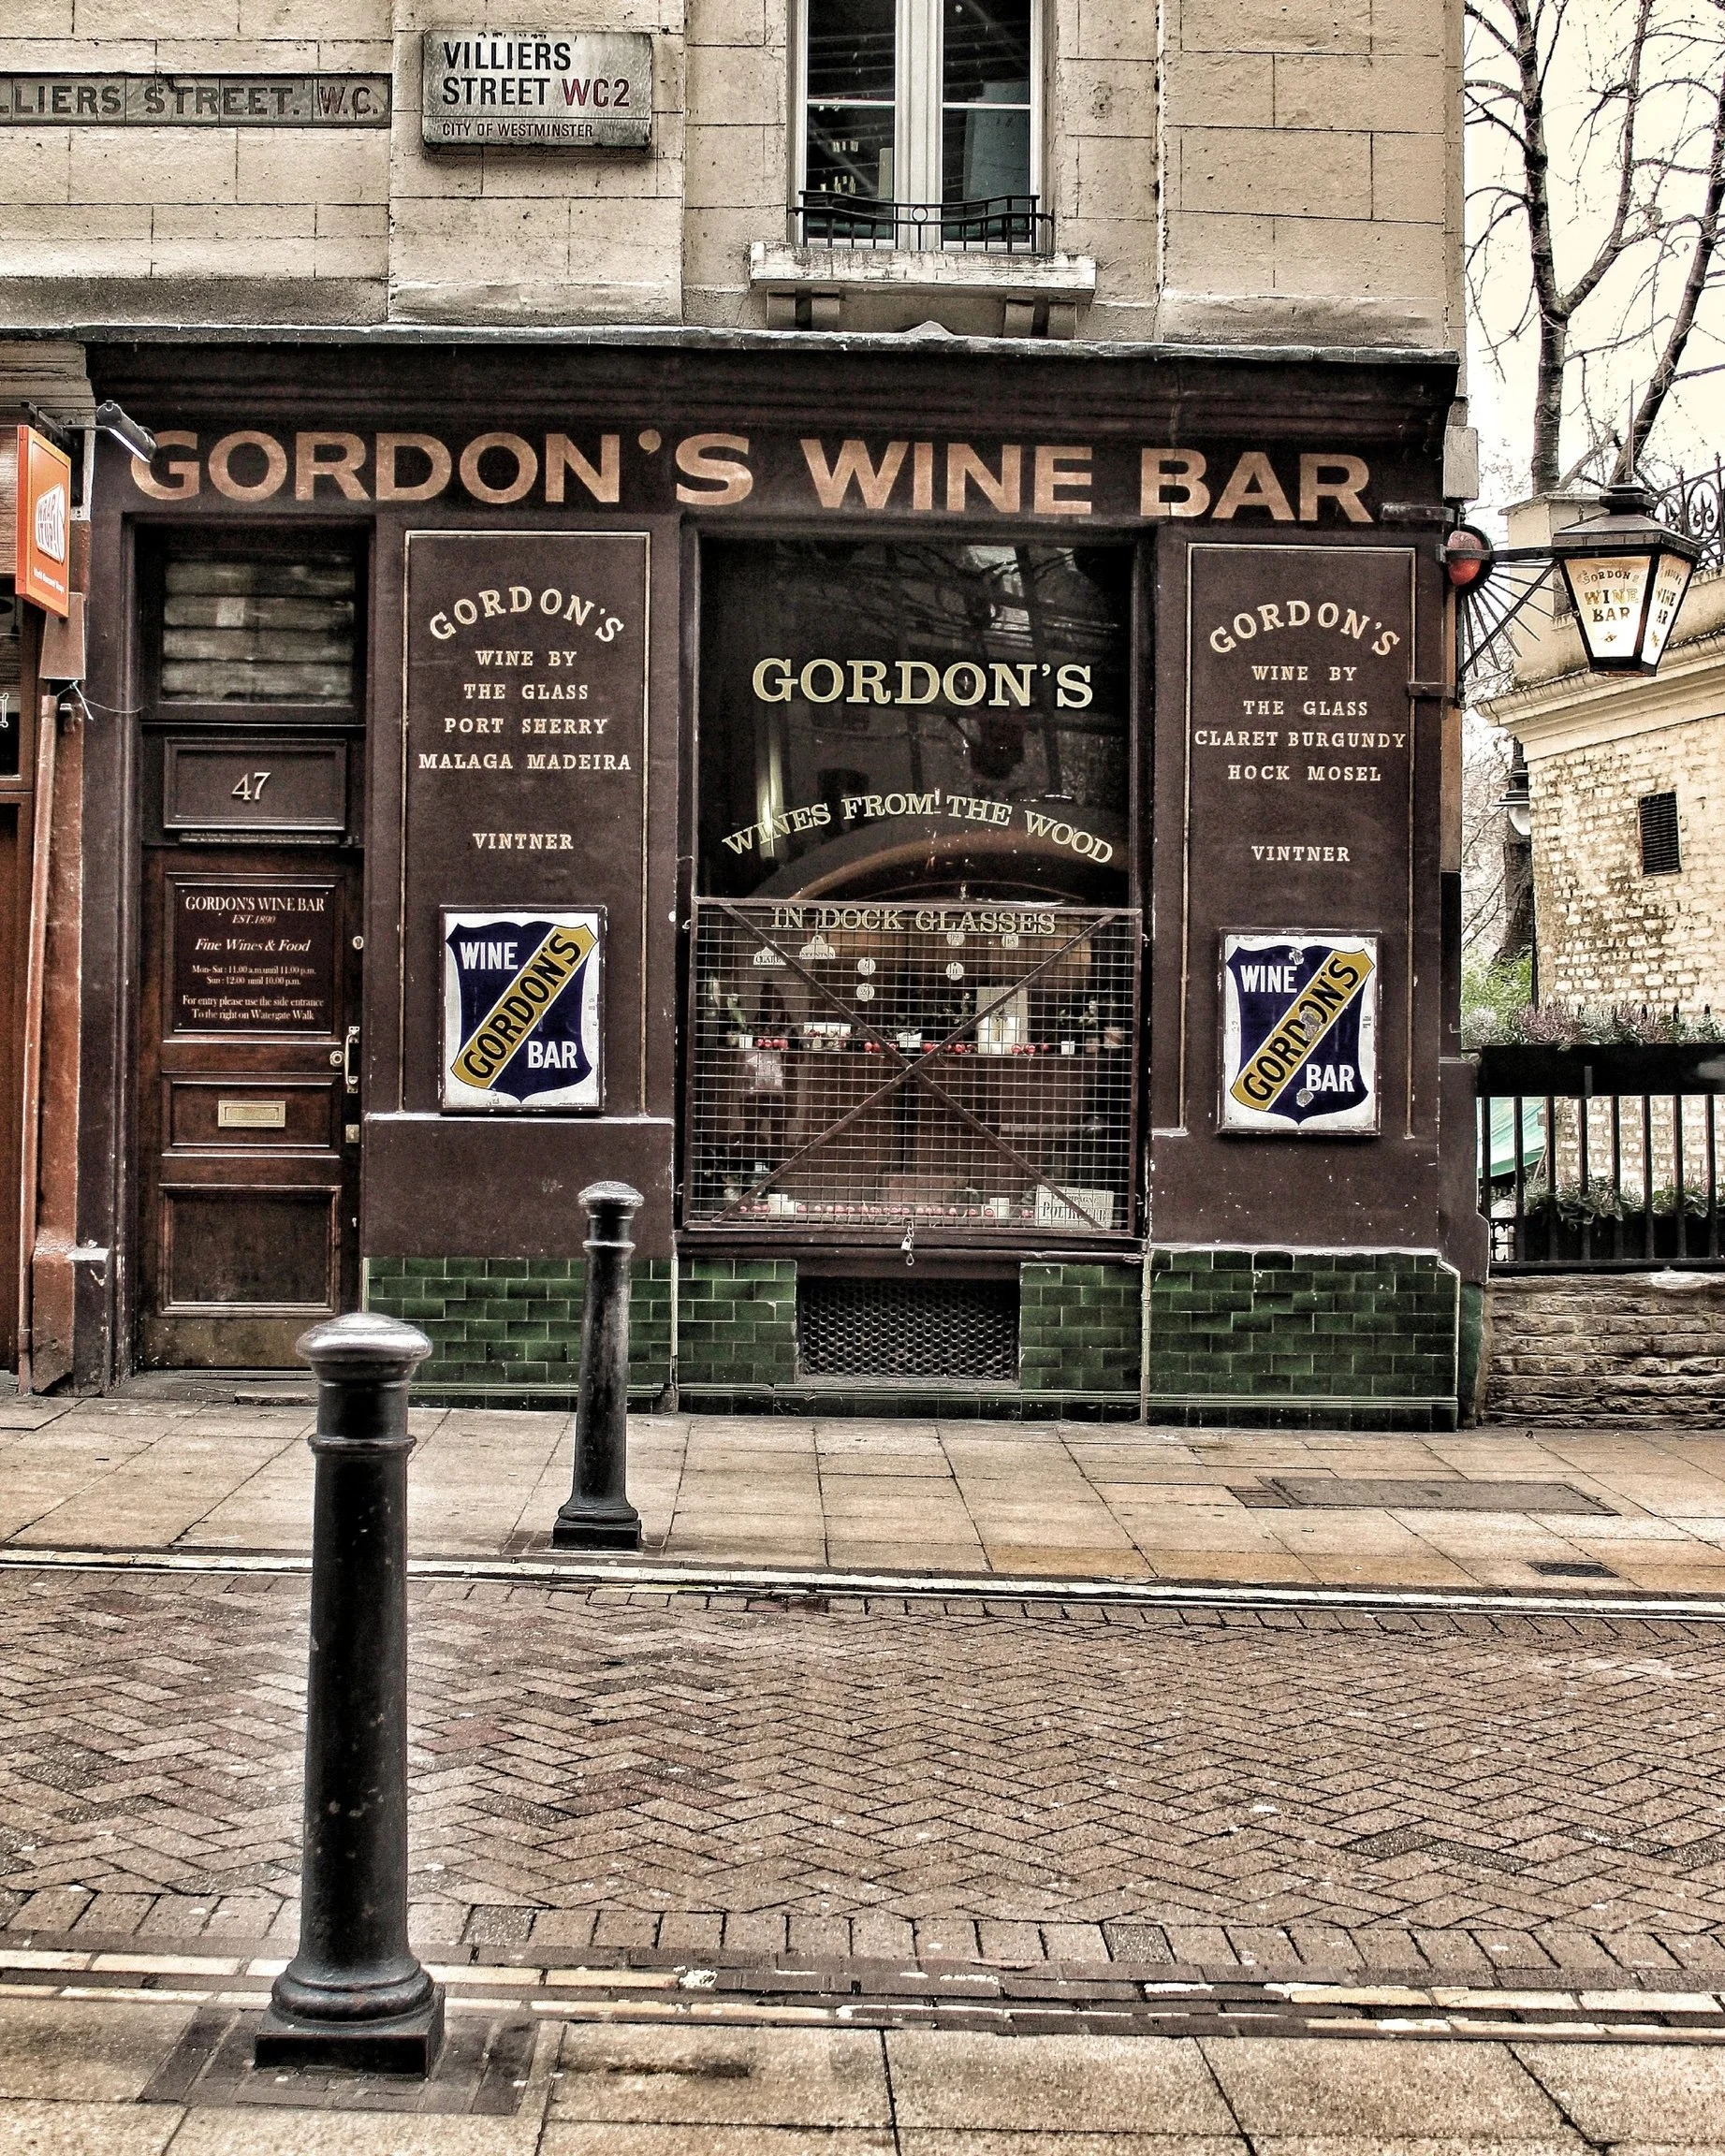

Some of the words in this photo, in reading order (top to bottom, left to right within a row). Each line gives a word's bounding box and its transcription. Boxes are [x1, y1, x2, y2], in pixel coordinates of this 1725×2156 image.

[443, 41, 572, 71] VILLIERS
[442, 78, 548, 106] STREET
[563, 79, 631, 109] WC2
[442, 123, 471, 138] CITY
[475, 123, 493, 138] OF
[497, 123, 594, 138] WESTMINSTER
[130, 429, 754, 507] GORDON'S
[800, 438, 1092, 516] WINE
[1139, 446, 1374, 524] BAR
[430, 586, 624, 643] GORDON'S
[1592, 606, 1630, 623] BAR
[1209, 599, 1401, 657] GORDON'S
[475, 650, 534, 666] WINE
[548, 650, 577, 667] BY
[752, 657, 1094, 708] GORDON'S
[1251, 665, 1308, 681] WINE
[1329, 666, 1357, 681] BY
[463, 683, 506, 700] THE
[521, 684, 589, 700] GLASS
[1243, 700, 1285, 716] THE
[1303, 701, 1368, 717] GLASS
[444, 717, 504, 734] PORT
[521, 718, 608, 735] SHERRY
[1194, 730, 1279, 747] CLARET
[1288, 731, 1407, 749] BURGUNDY
[418, 753, 514, 769] MALAGA
[527, 754, 632, 771] MADEIRA
[1228, 765, 1291, 780] HOCK
[1308, 765, 1382, 781] MOSEL
[231, 772, 271, 801] 47
[722, 802, 832, 856] WINES
[946, 794, 1013, 827] THE
[1024, 809, 1114, 866] WOOD
[472, 833, 574, 850] VINTNER
[1250, 845, 1352, 863] VINTNER
[185, 896, 256, 911] GORDON'S
[257, 896, 296, 912] WINE
[298, 897, 325, 912] BAR
[770, 907, 804, 929] IN
[819, 908, 905, 931] DOCK
[915, 910, 1057, 936] GLASSES
[195, 938, 223, 951] Fine
[227, 939, 263, 951] Wines
[265, 939, 276, 952] &
[278, 940, 312, 952] Food
[459, 941, 519, 970] WINE
[1240, 965, 1298, 994] WINE
[183, 995, 197, 1005] For
[197, 997, 217, 1007] entry
[219, 996, 243, 1007] please
[244, 998, 258, 1006] use
[259, 996, 272, 1006] the
[273, 996, 288, 1006] side
[290, 998, 325, 1007] entrance
[462, 933, 582, 1080] GORDON'S
[219, 1009, 238, 1020] right
[250, 1009, 291, 1020] Watergate
[292, 1010, 314, 1020] Walk
[1242, 957, 1359, 1102] GORDON'S
[527, 1041, 578, 1069] BAR
[1306, 1064, 1356, 1093] BAR
